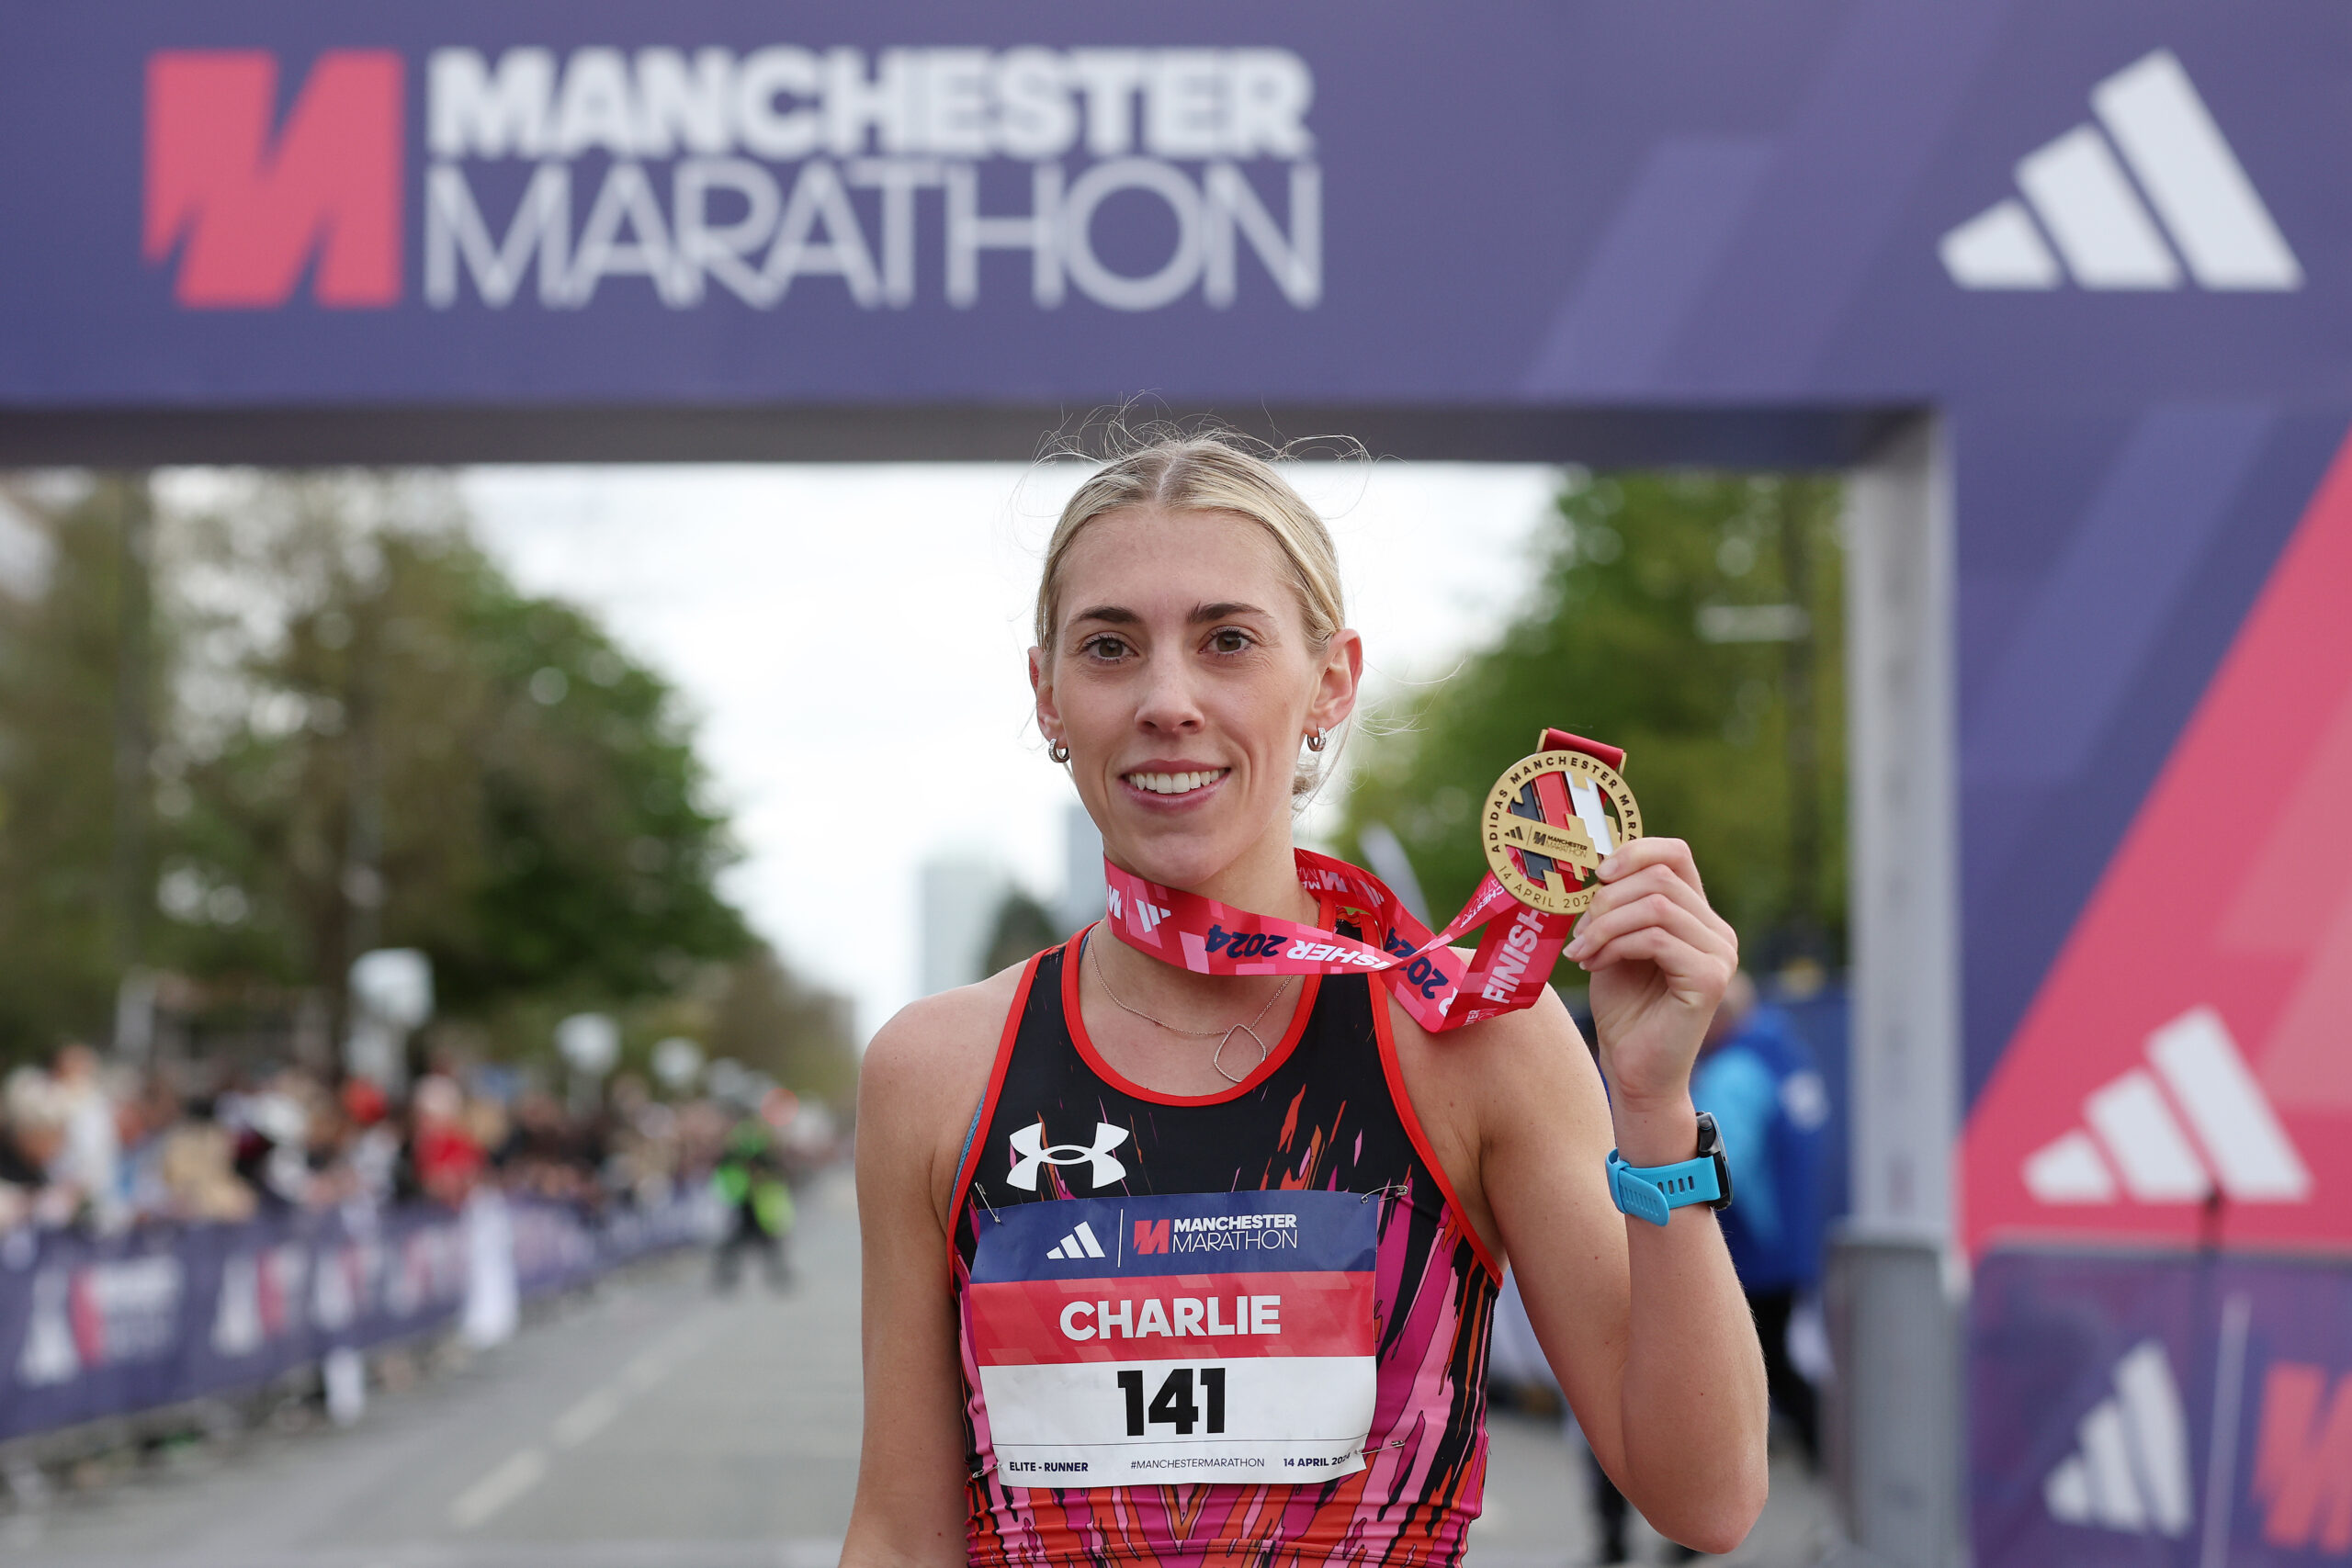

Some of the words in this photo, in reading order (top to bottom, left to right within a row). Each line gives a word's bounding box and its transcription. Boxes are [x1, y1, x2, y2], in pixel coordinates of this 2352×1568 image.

[426, 45, 1315, 161] MANCHESTER
[424, 158, 1322, 311] MARATHON
[1488, 789, 1509, 853] ADIDAS
[1510, 756, 1618, 789] MANCHESTER
[1545, 840, 1587, 858] MARATHON
[1547, 835, 1588, 851] MANCHESTER
[1498, 865, 1511, 880] 14
[1514, 883, 1555, 908] APRIL
[1204, 923, 1288, 959] 2024
[1173, 1214, 1297, 1233] MANCHESTER
[1172, 1229, 1297, 1254] MARATHON
[1059, 1295, 1281, 1341] CHARLIE
[1117, 1368, 1226, 1437] 141
[1010, 1461, 1035, 1472] ELITE
[1044, 1461, 1089, 1472] RUNNER
[1130, 1458, 1265, 1470] #MANCHESTERMARATHON
[1283, 1458, 1295, 1467] 14
[1297, 1458, 1329, 1467] APRIL
